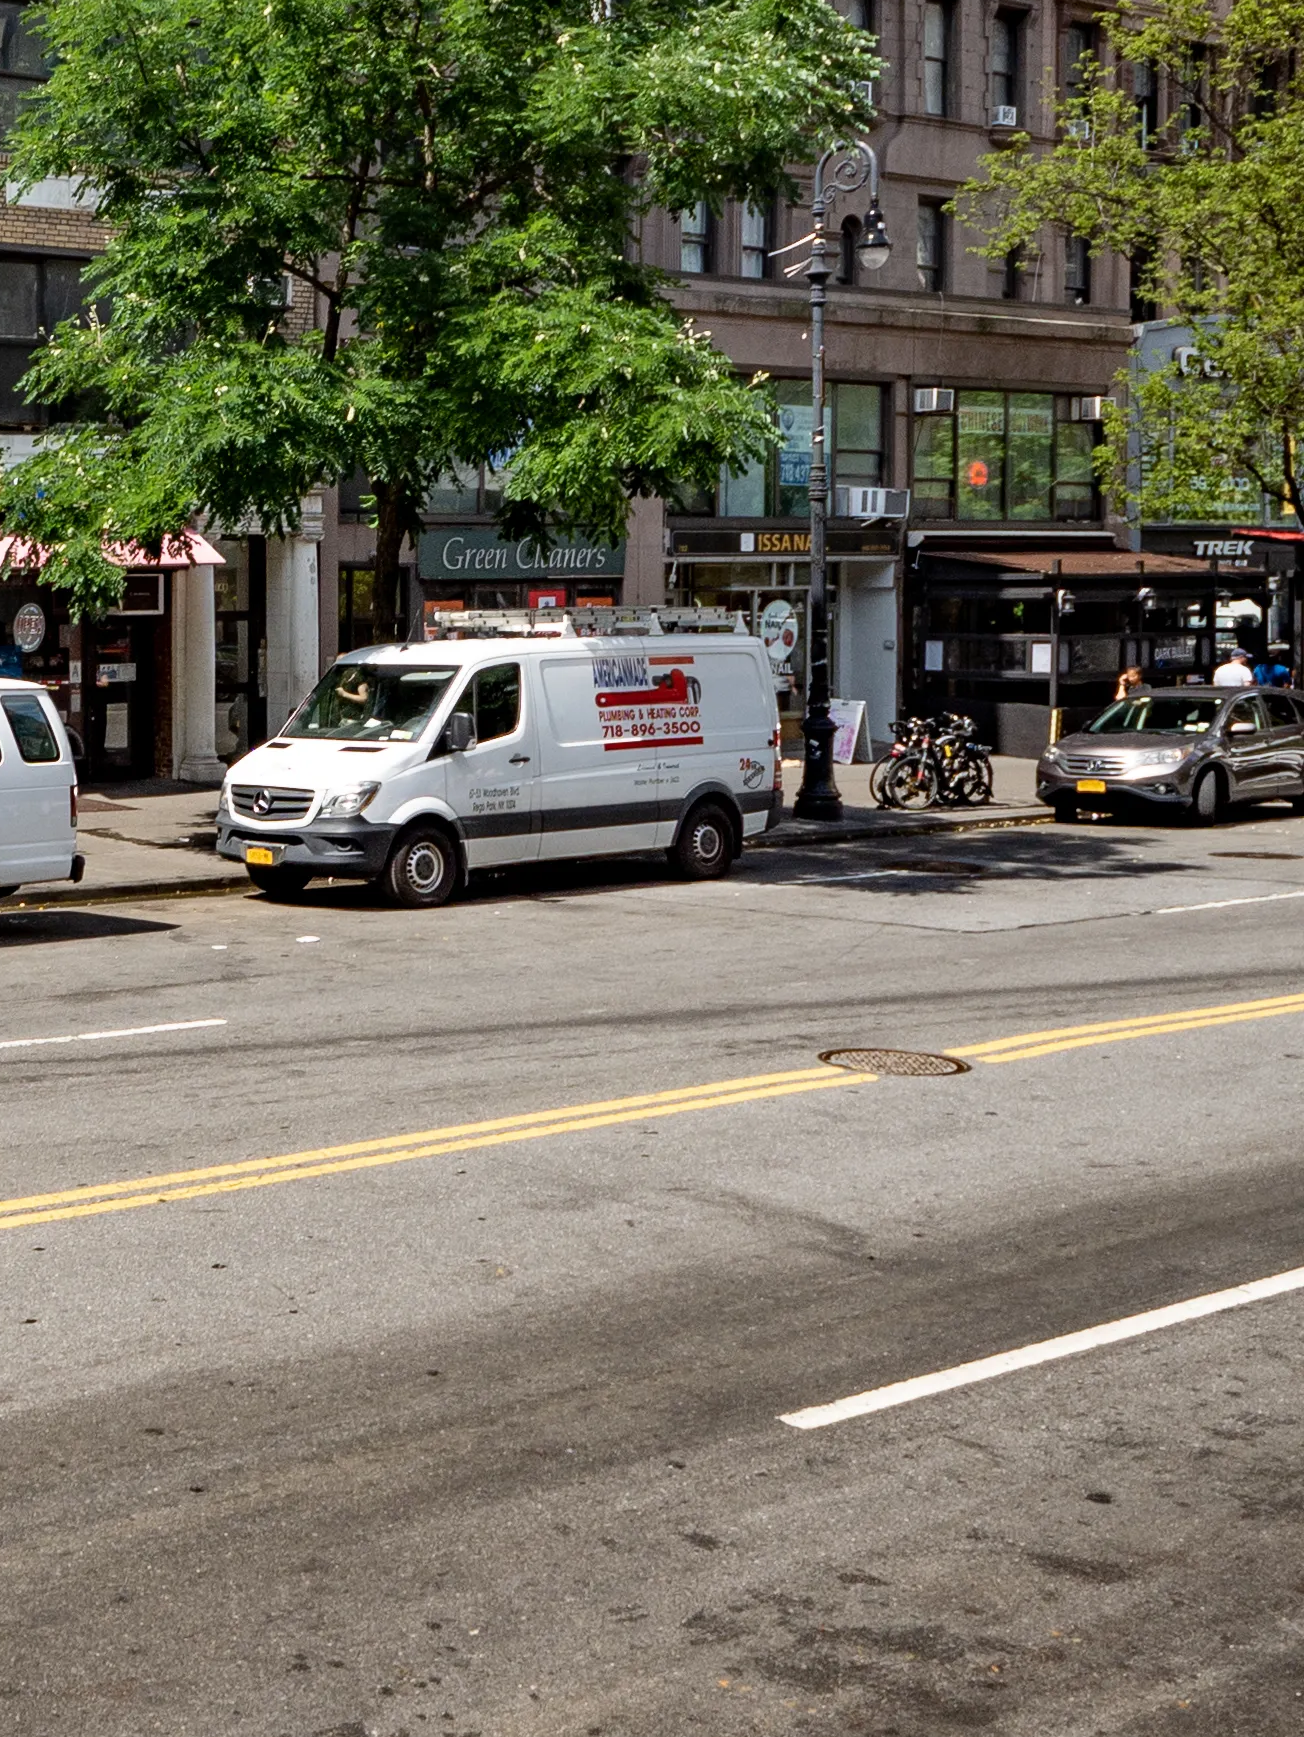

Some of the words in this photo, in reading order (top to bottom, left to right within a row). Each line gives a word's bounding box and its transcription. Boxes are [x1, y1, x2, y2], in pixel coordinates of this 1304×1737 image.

[758, 534, 791, 552] ISSA
[1194, 539, 1255, 556] TREK
[442, 536, 507, 570] Green
[599, 709, 636, 723] PLUMBING
[639, 710, 644, 721] &
[647, 707, 676, 720] HEATING
[679, 705, 702, 719] CORP.
[602, 720, 701, 738] 718-896-3500
[739, 757, 751, 771] 24
